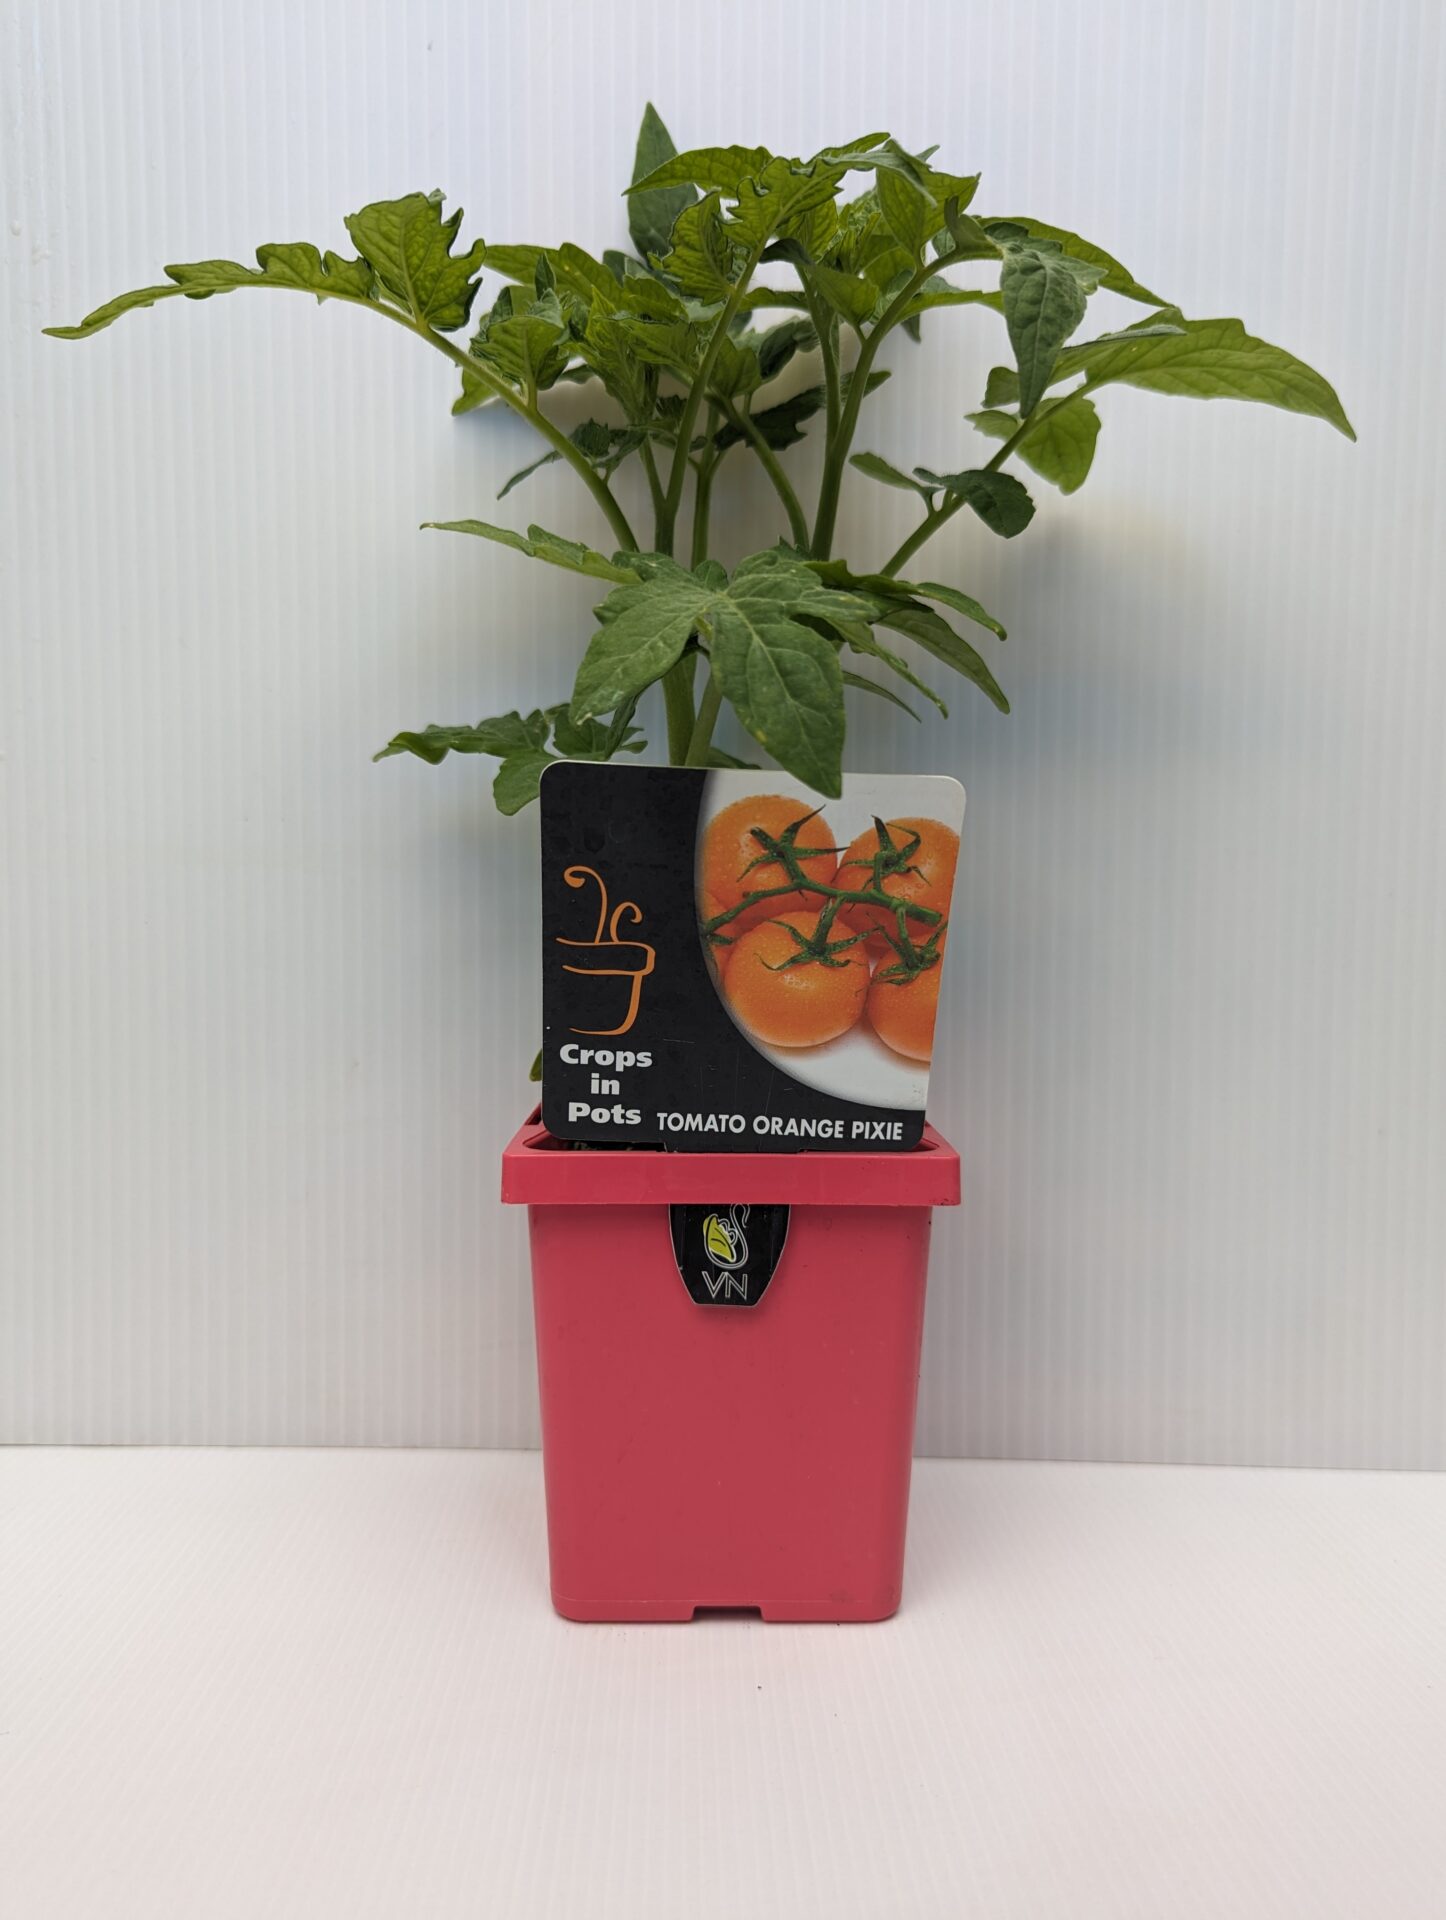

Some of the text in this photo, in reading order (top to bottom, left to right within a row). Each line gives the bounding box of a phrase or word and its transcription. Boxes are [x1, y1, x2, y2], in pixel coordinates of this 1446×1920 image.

[559, 1043, 653, 1072] Crops
[590, 1073, 620, 1095] in
[568, 1102, 642, 1125] Pots
[657, 1111, 904, 1141] TOMATO ORANGE PIXIE
[702, 1271, 748, 1300] VN
